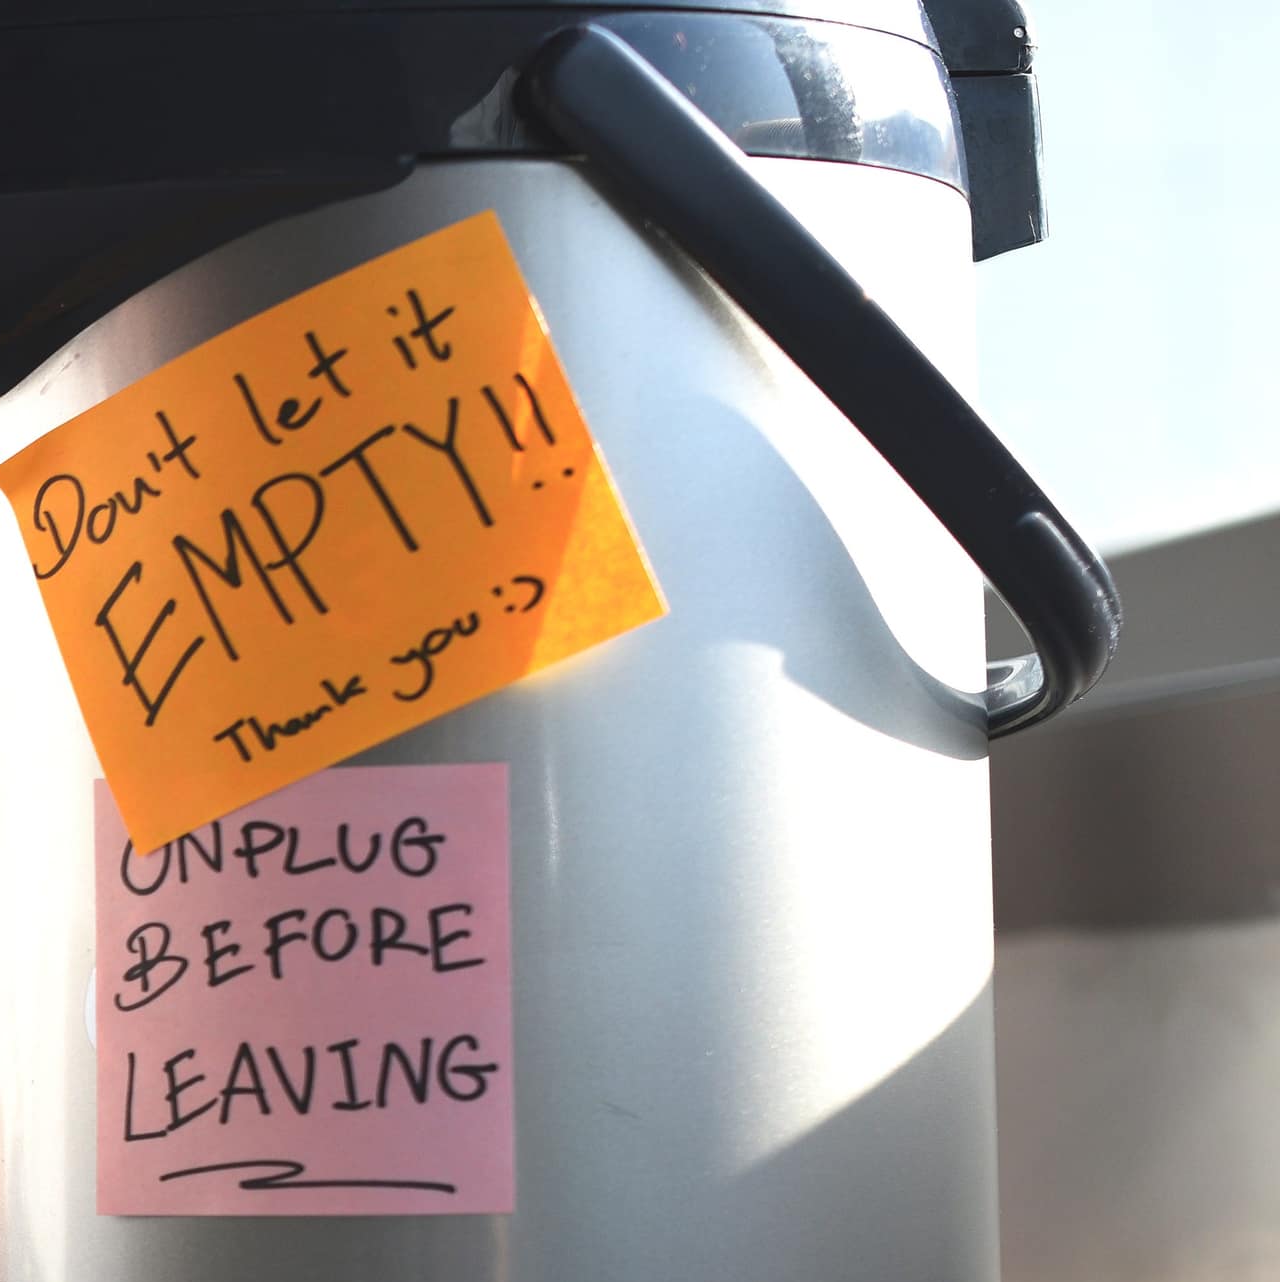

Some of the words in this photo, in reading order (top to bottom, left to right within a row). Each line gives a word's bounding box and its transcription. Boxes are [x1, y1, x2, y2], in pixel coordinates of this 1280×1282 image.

[32, 411, 200, 580] Don't
[234, 332, 350, 445] let
[386, 290, 455, 370] it
[95, 373, 575, 727] EMPTY!!
[214, 675, 367, 763] Thank
[391, 612, 479, 702] you
[120, 816, 446, 896] UNPLUG
[114, 903, 485, 1012] BEFORE
[124, 1034, 499, 1142] LEAVING
